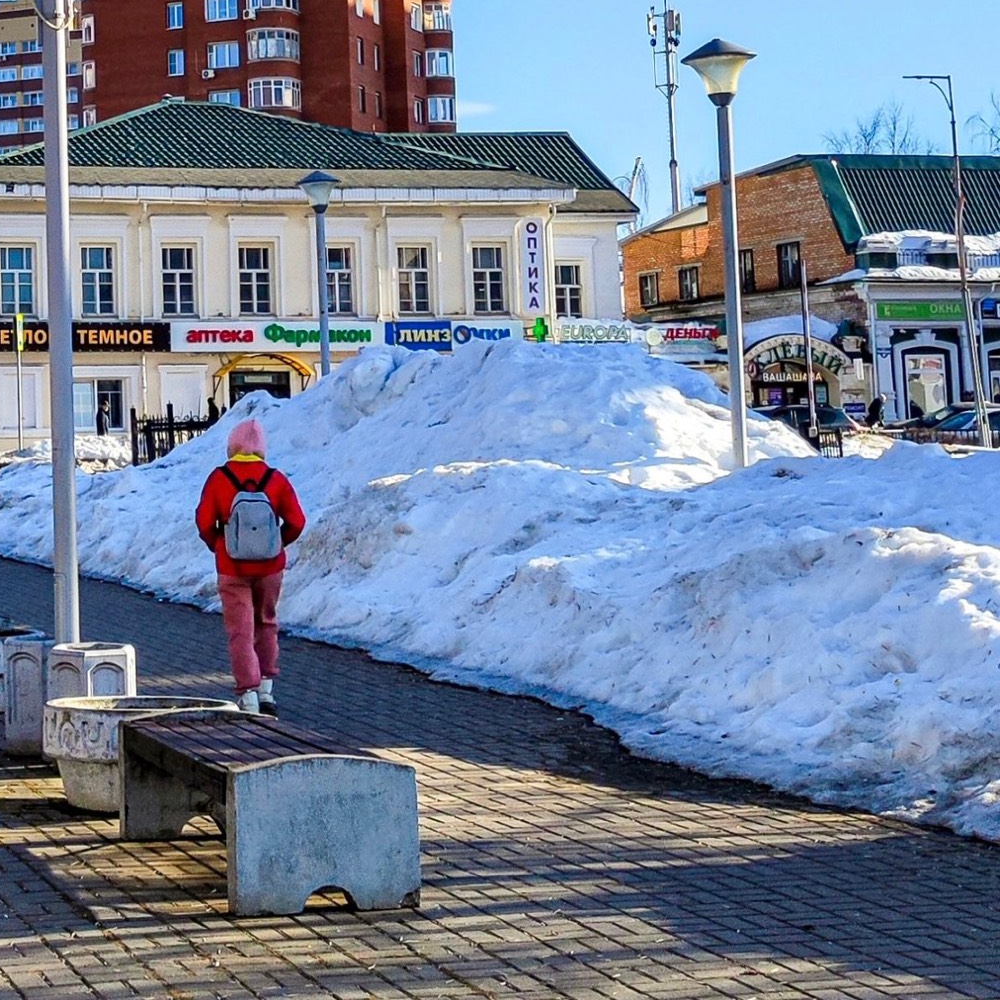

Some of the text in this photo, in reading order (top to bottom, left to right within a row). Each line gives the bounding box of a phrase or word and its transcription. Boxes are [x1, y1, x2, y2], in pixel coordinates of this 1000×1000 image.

[526, 222, 539, 308] ОПТИКА
[929, 304, 962, 313] ОКНА
[77, 329, 153, 345] ТЕМНОЕ
[186, 328, 254, 343] аптека
[560, 325, 628, 340] EUROPA
